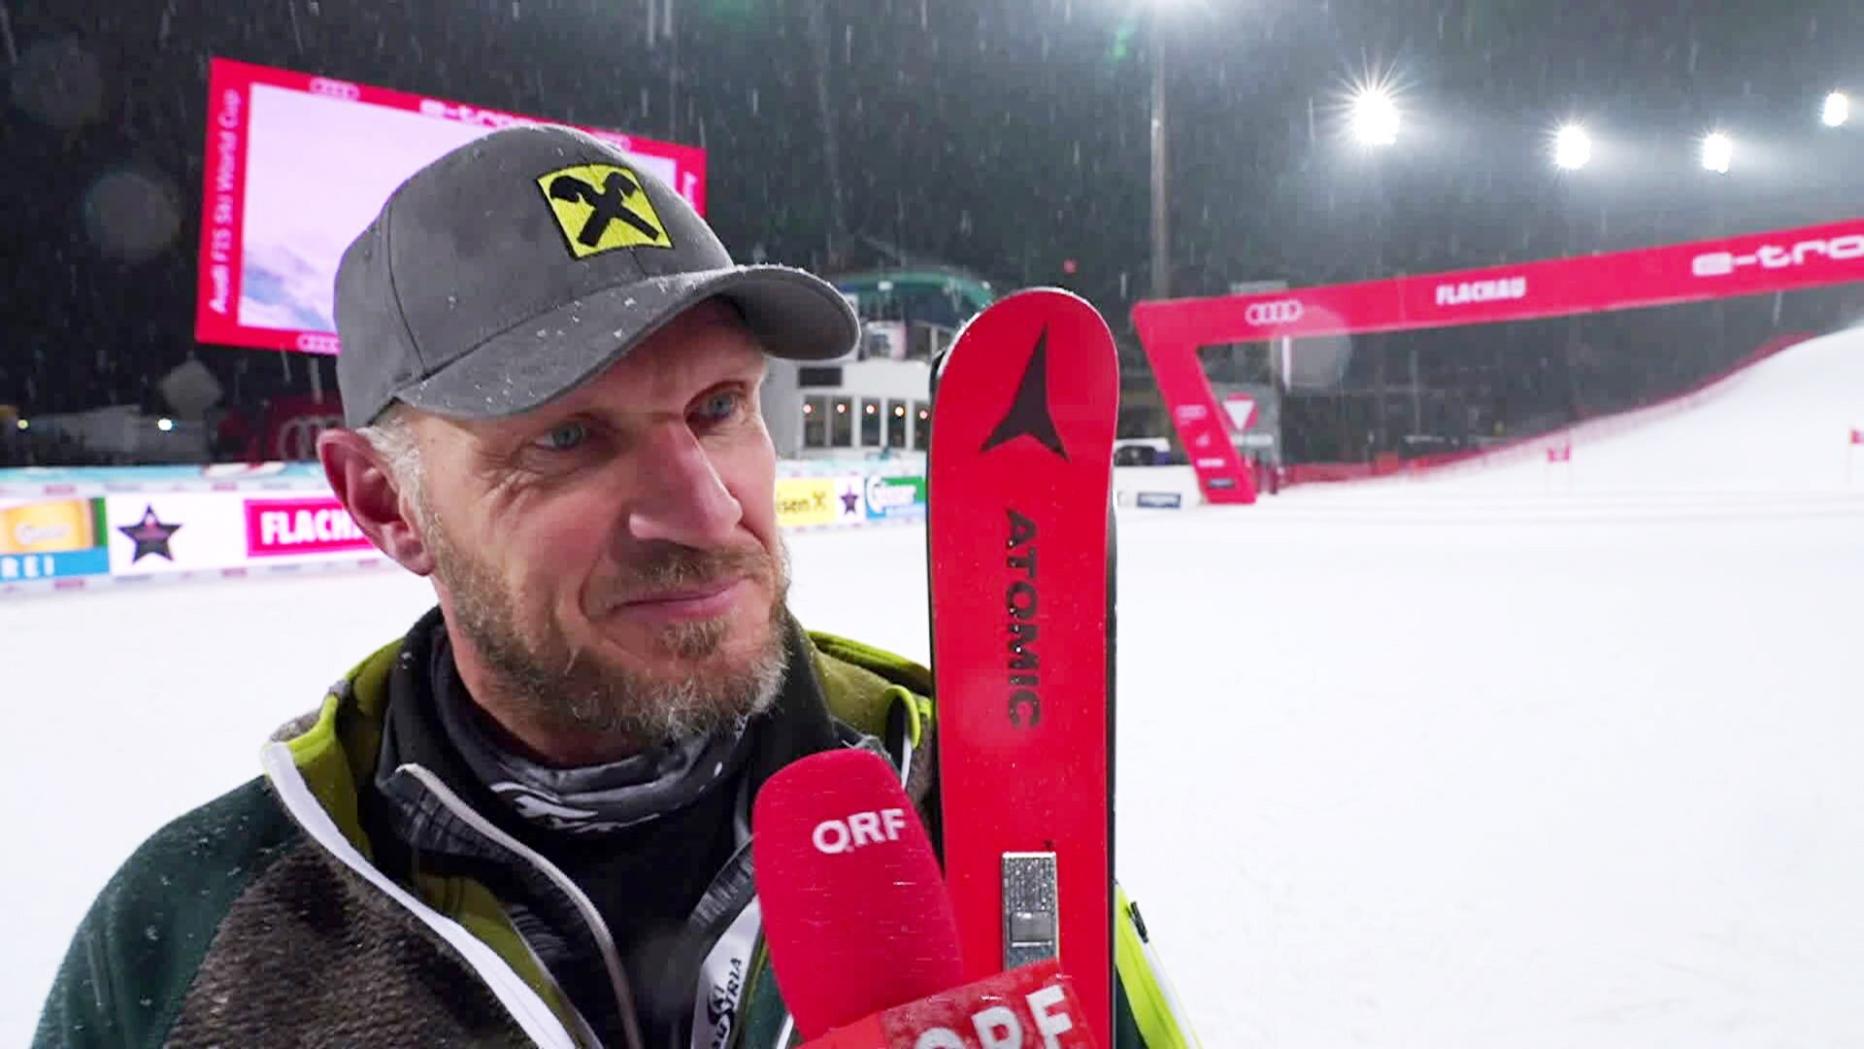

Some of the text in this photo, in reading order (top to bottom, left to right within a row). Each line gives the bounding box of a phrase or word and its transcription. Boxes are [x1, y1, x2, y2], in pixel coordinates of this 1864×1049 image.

[209, 88, 241, 314] Audi FIS Ski World Cup
[1435, 277, 1526, 306] FLACHAU
[1006, 508, 1041, 728] ATOMIC
[812, 808, 906, 854] ORF
